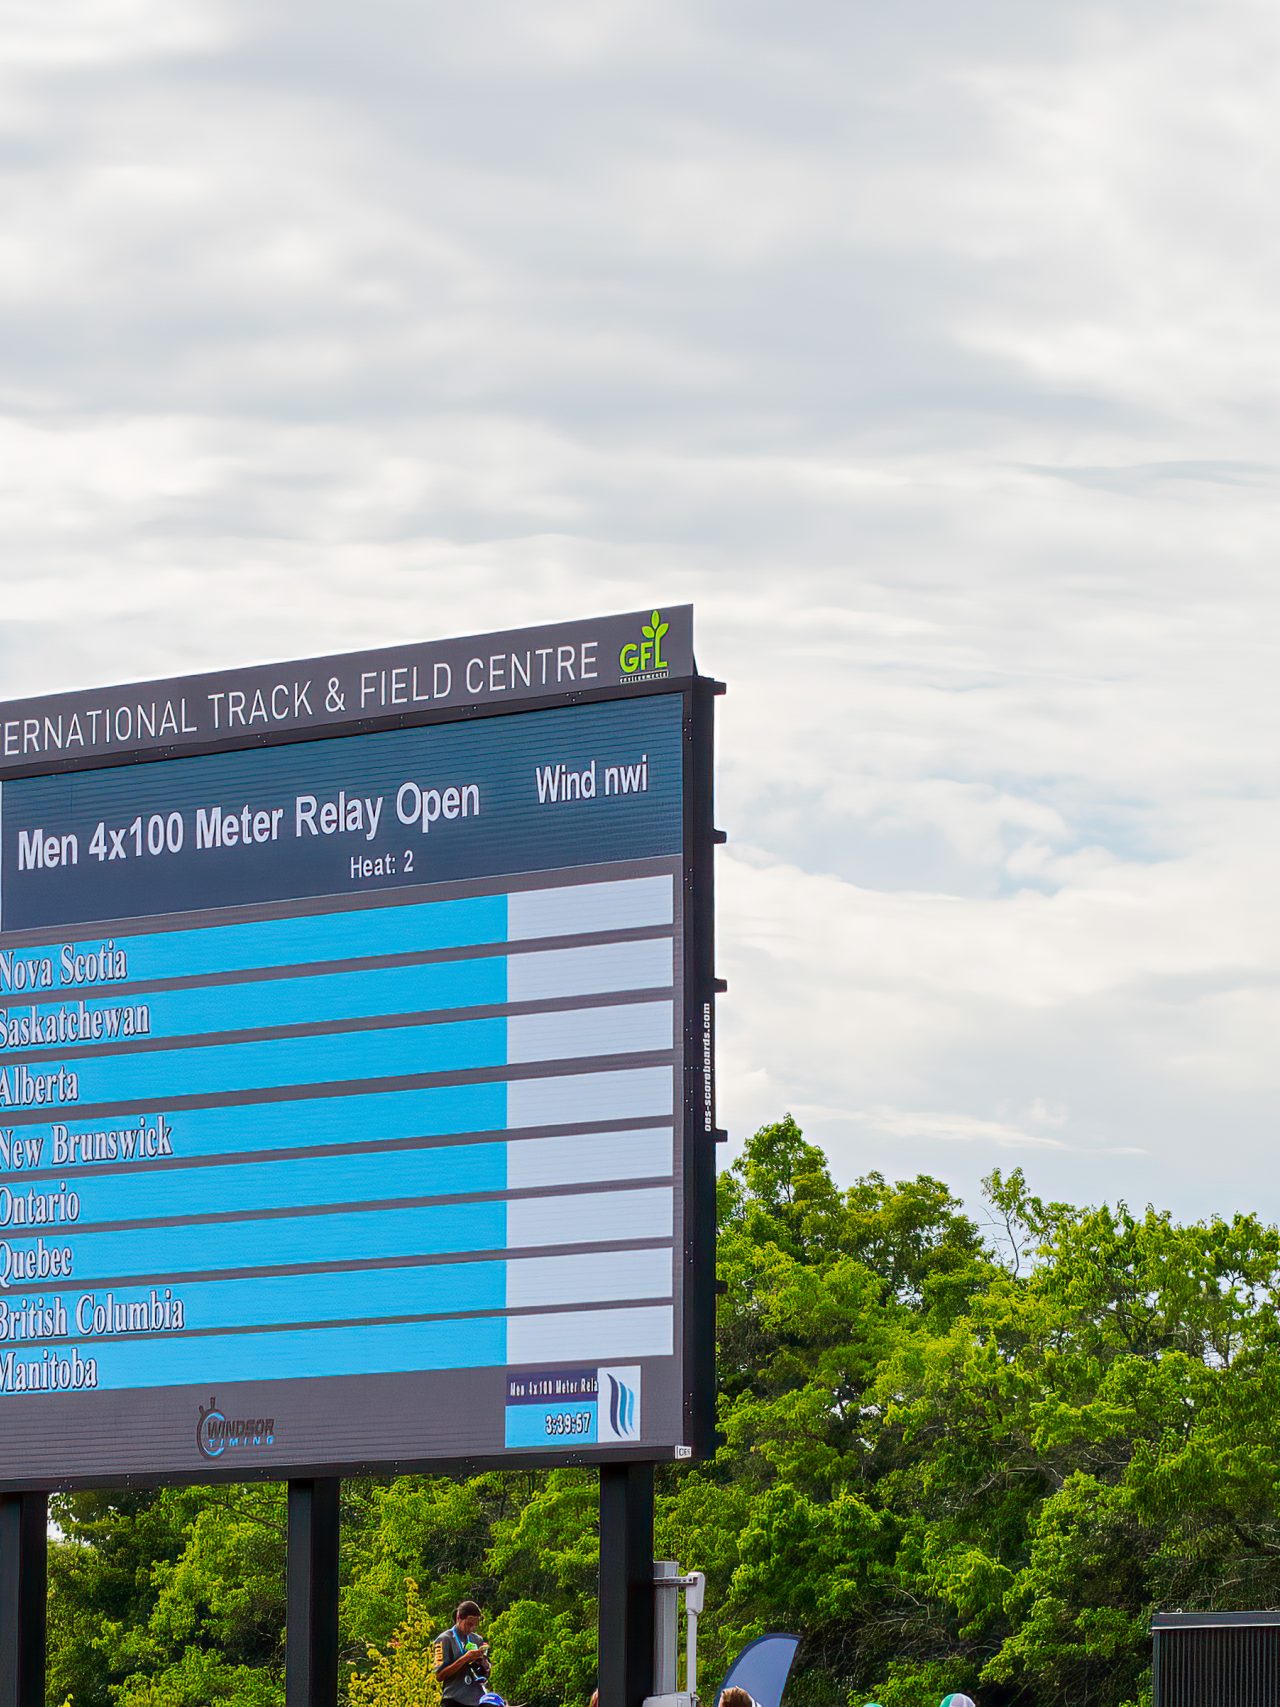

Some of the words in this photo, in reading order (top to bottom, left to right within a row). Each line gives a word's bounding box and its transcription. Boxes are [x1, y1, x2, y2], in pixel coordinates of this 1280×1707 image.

[620, 610, 670, 673] GFL
[207, 680, 314, 729] TRACK
[324, 676, 347, 713] &
[359, 662, 452, 709] FIELD
[465, 641, 600, 693] CENTRE
[535, 760, 597, 805] Wind
[604, 754, 649, 795] nwi
[17, 829, 79, 872] Men
[88, 811, 185, 863] 4x100
[195, 804, 285, 851] Meter
[295, 791, 384, 841] Relay
[396, 781, 481, 834] Open
[350, 855, 397, 880] Heat:
[403, 850, 415, 873] 2
[59, 938, 128, 986] Scotia
[51, 1115, 173, 1165] Brunswick
[75, 1288, 184, 1336] Columbia
[555, 1379, 578, 1394] Meter
[207, 1418, 275, 1438] WINDSOR
[208, 1435, 275, 1448] TIMING
